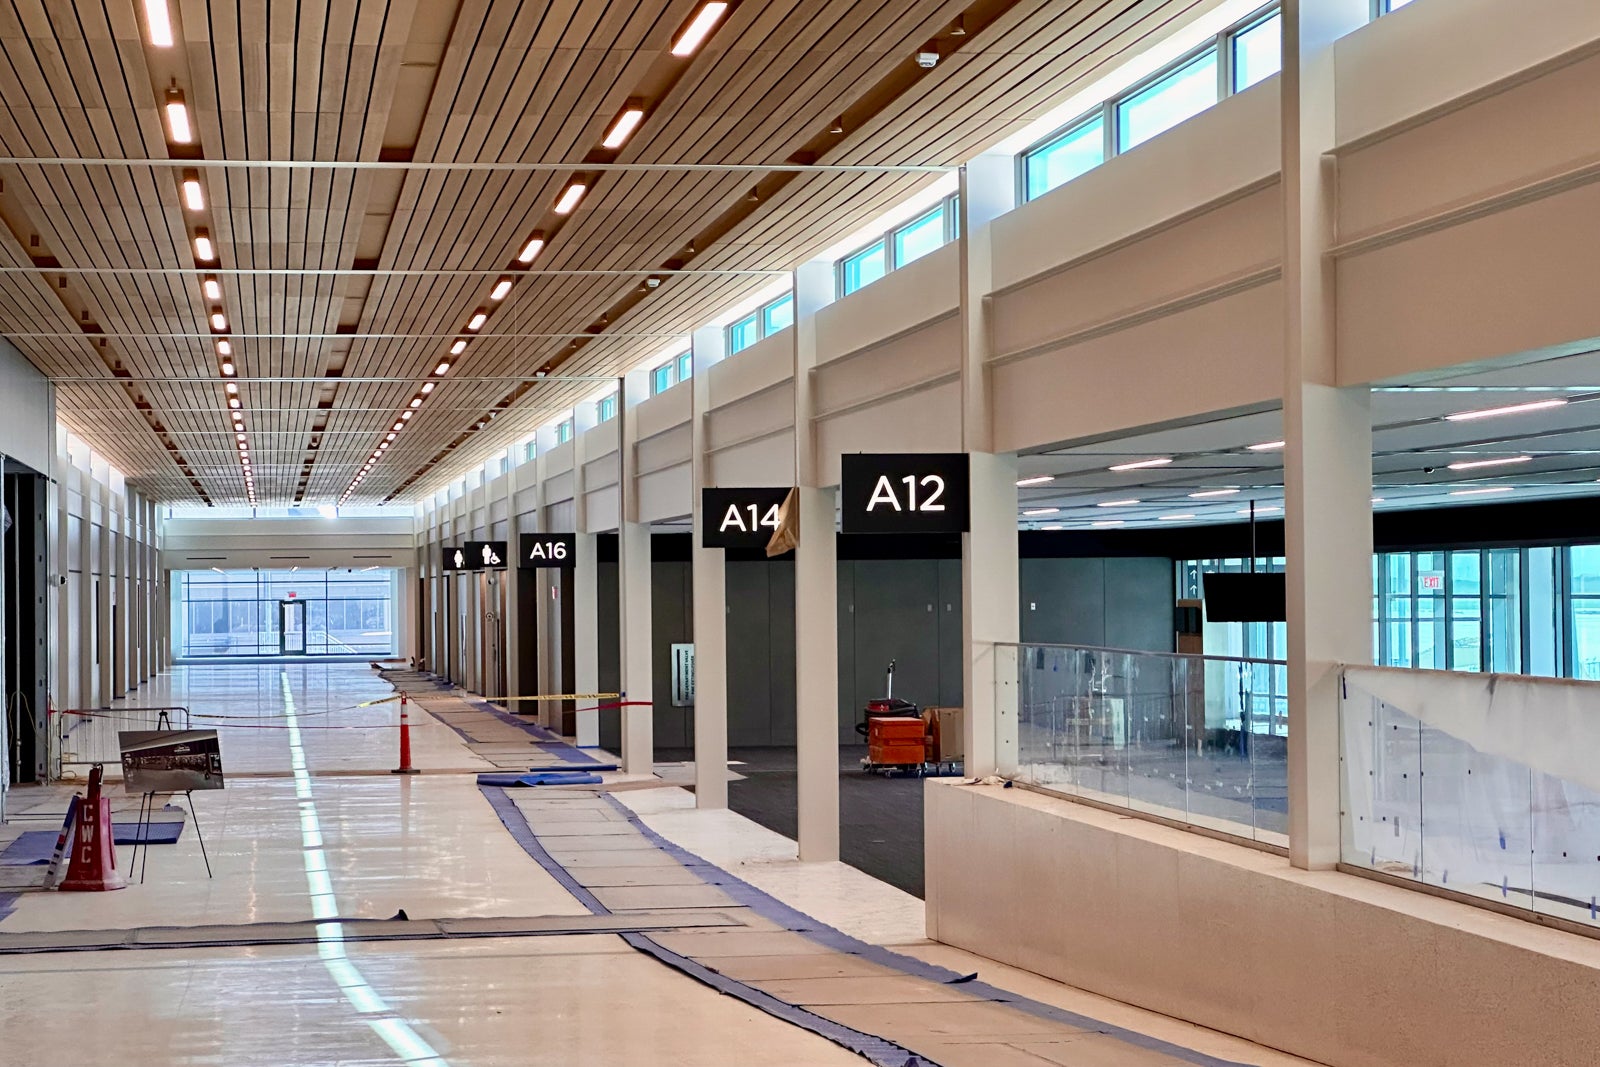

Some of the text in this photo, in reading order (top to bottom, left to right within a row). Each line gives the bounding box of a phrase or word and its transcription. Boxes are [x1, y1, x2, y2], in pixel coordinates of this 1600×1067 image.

[866, 474, 946, 512] A12
[719, 503, 781, 532] A14
[529, 541, 567, 560] A16
[1424, 576, 1439, 588] EXIT
[80, 804, 94, 864] CWC
